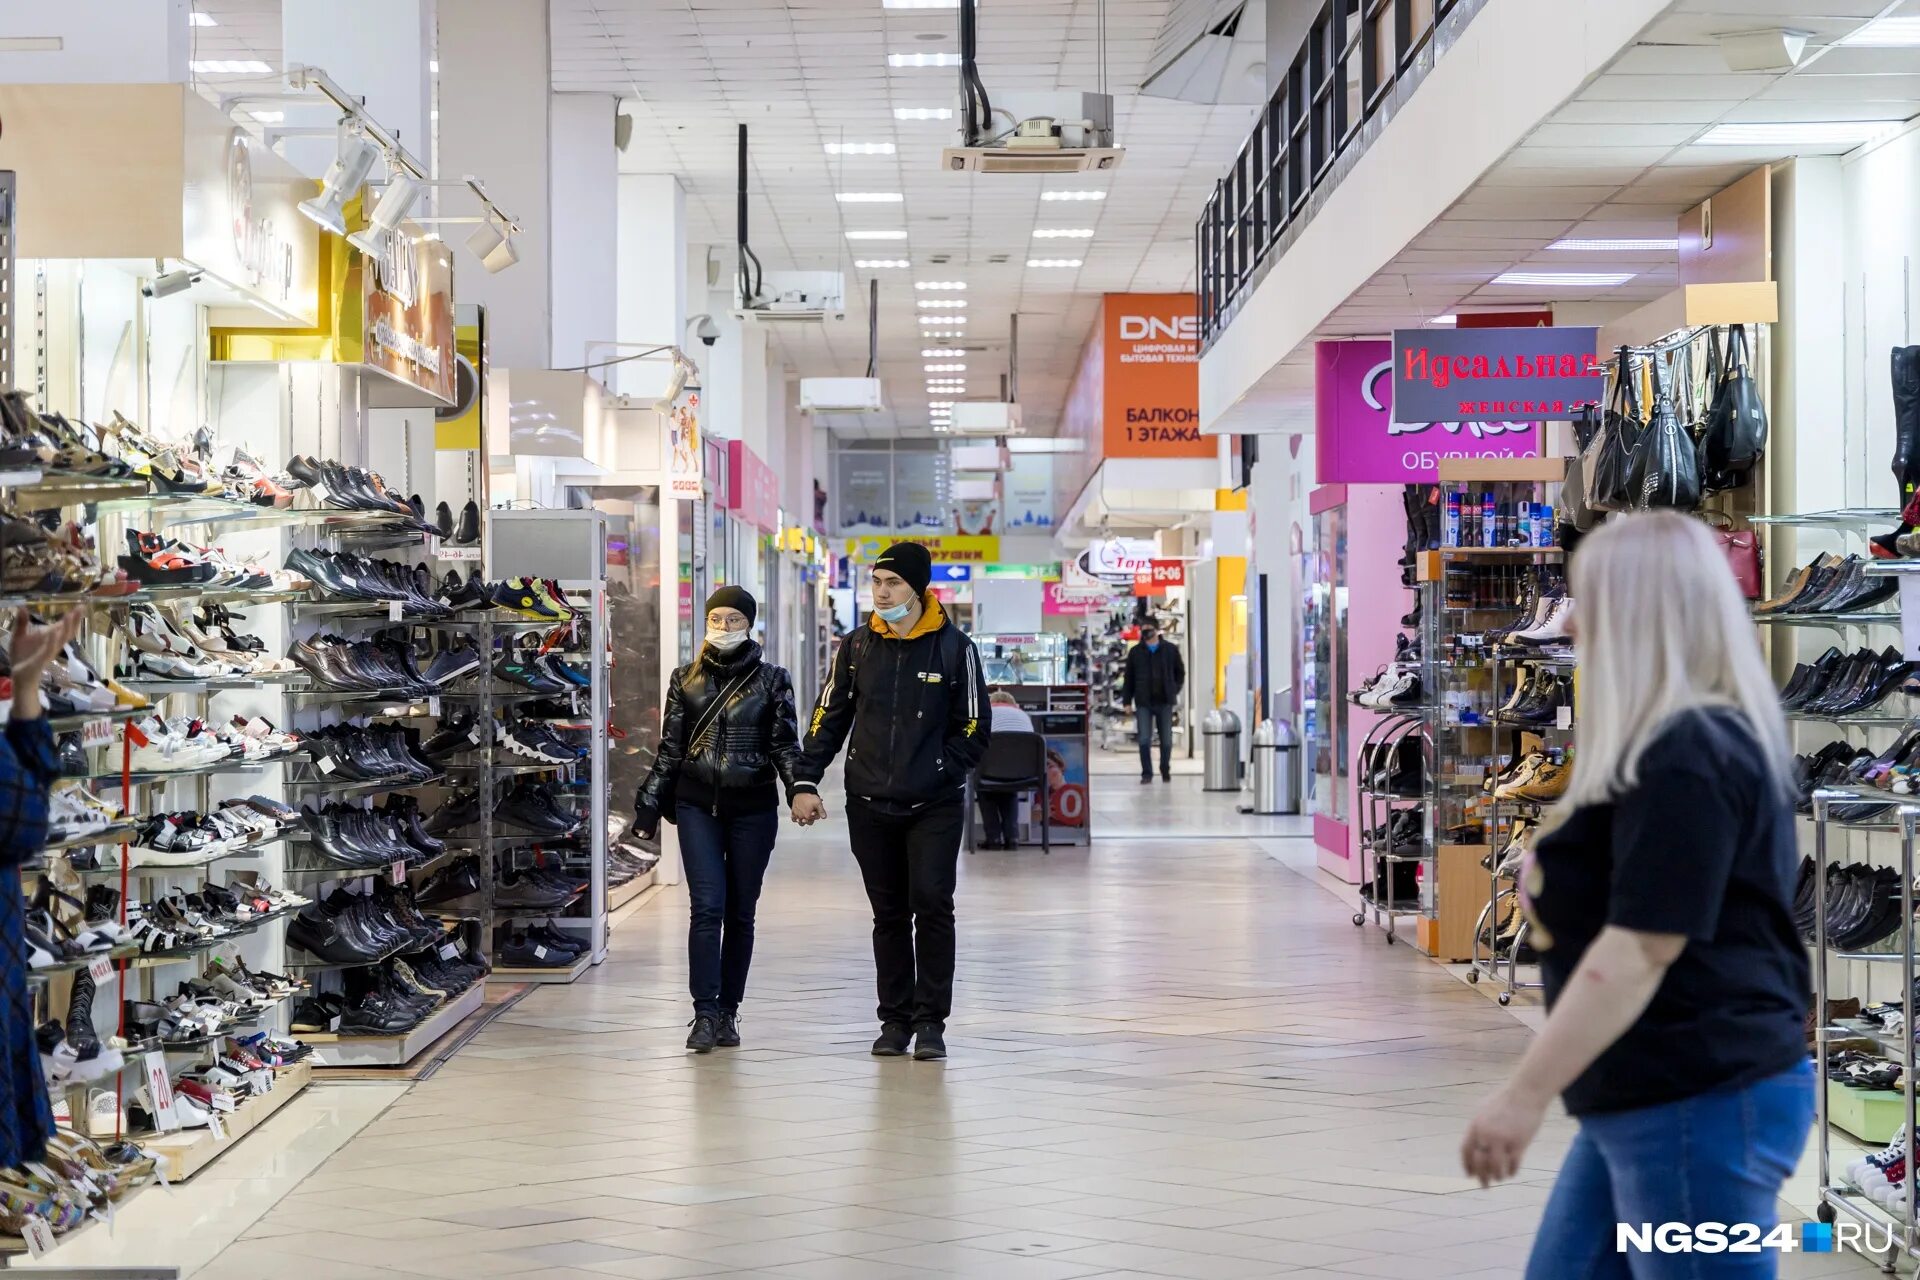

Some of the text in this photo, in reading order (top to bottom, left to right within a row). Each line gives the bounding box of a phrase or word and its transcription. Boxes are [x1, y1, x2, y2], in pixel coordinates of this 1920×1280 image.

[1119, 315, 1203, 340] DNS
[1133, 344, 1185, 353] ЦИФРОВАЯ
[1120, 353, 1164, 363] БЫТОВАЯ
[1403, 347, 1600, 388] Идеальная
[1458, 400, 1564, 414] ЖЕНСКАЯ
[1126, 407, 1200, 423] БАЛКОН
[1127, 427, 1201, 441] 1 ЭТАЖА
